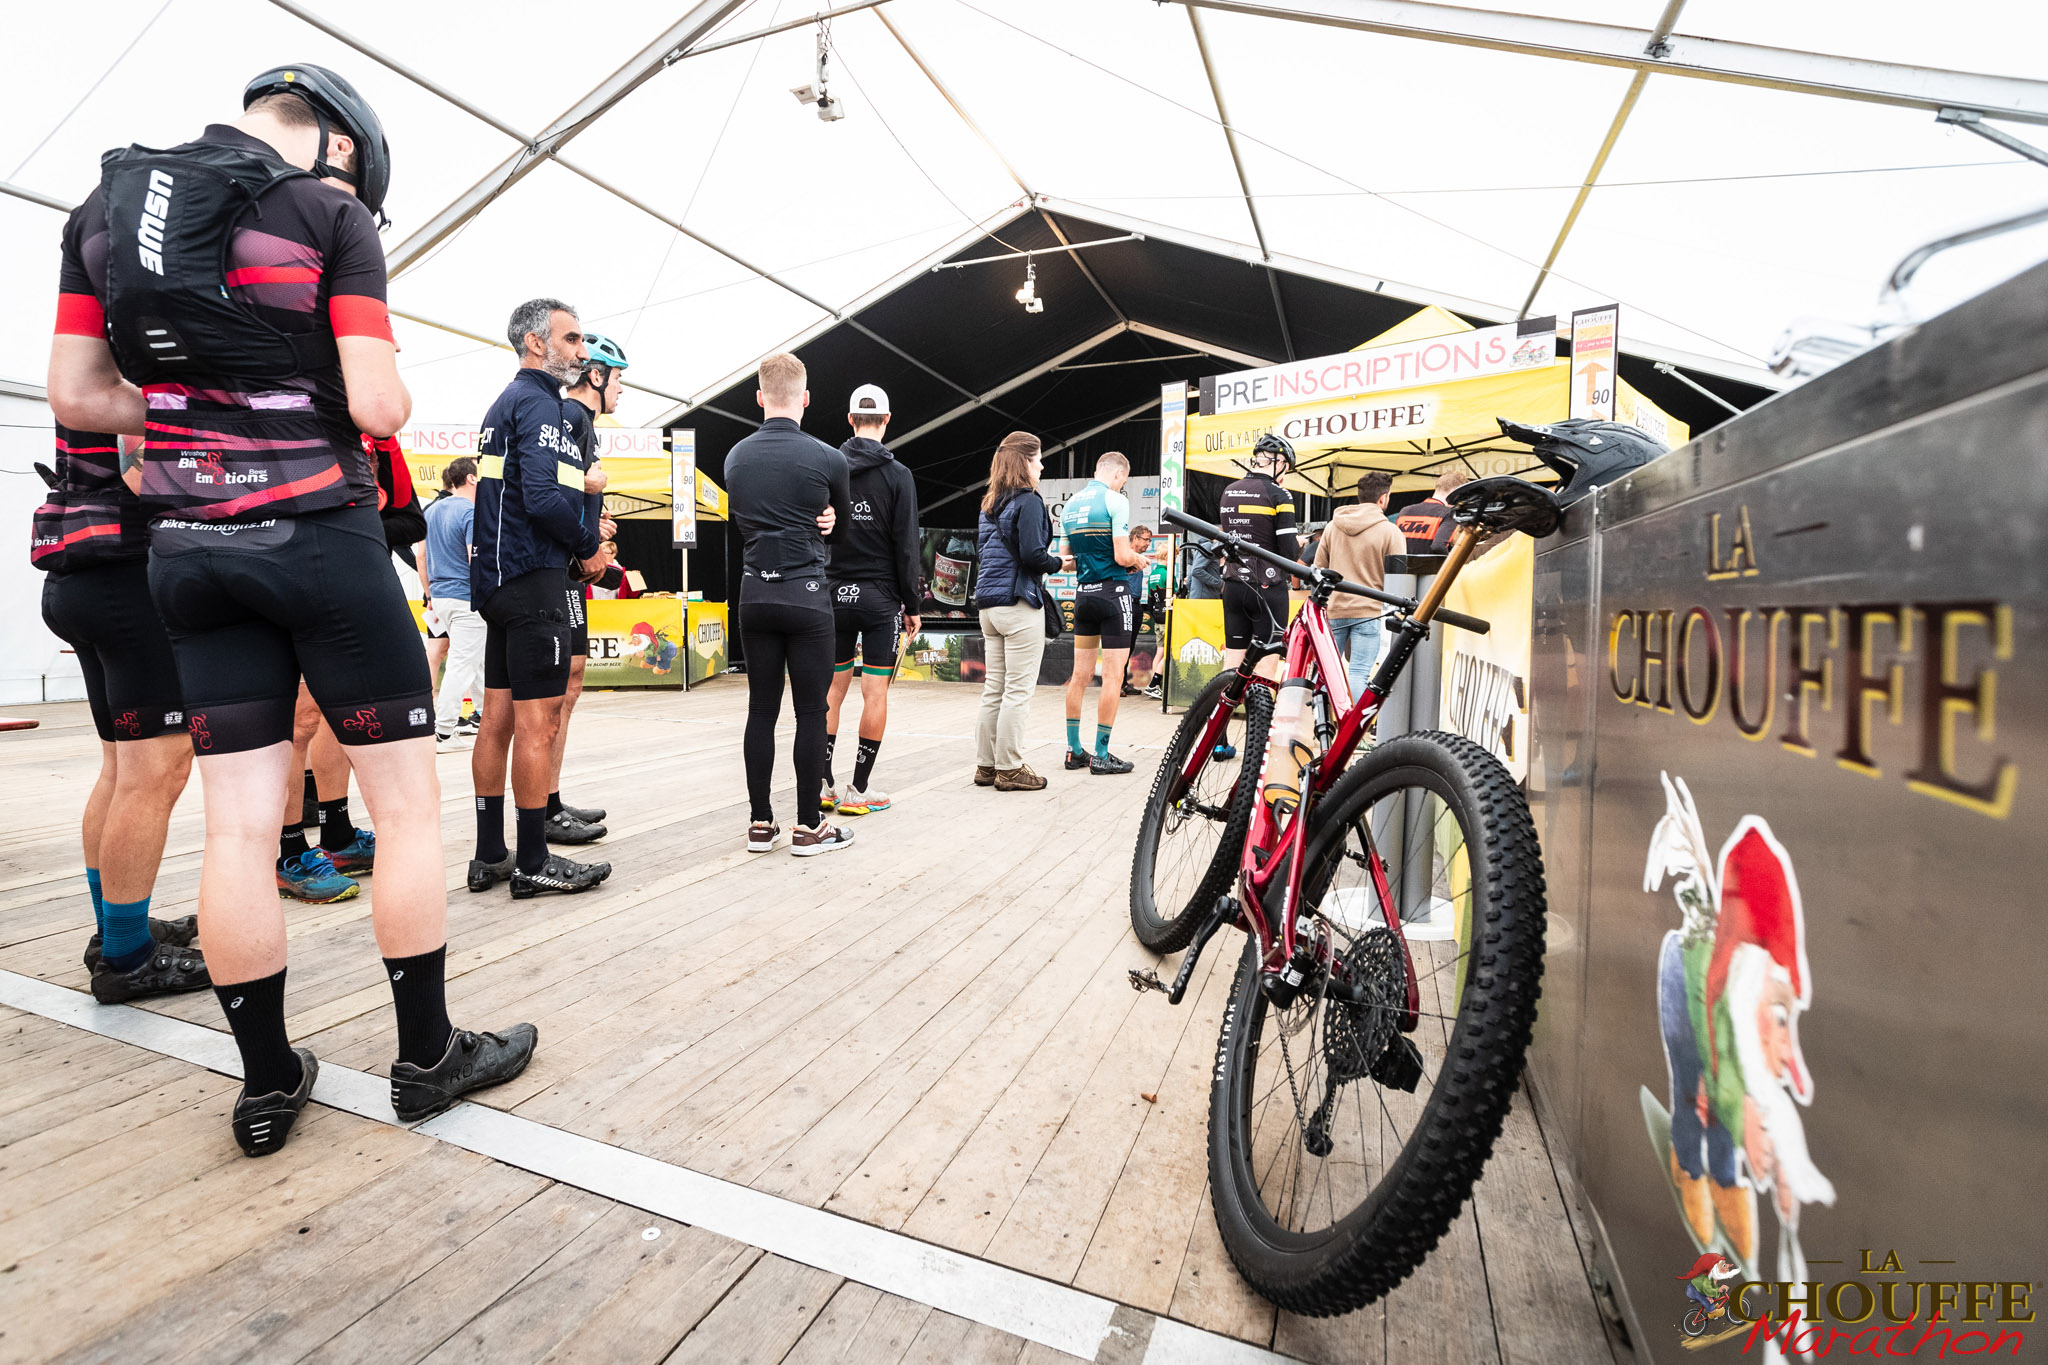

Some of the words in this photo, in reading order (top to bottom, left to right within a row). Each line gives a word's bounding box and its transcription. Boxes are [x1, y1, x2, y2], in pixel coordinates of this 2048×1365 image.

[138, 169, 173, 276] USWE
[1218, 377, 1268, 408] PRE
[1273, 337, 1506, 398] INSCRIPTIONS
[1592, 388, 1609, 405] 90
[1283, 402, 1426, 440] CHOUFFE
[603, 434, 661, 456] JOUR
[1172, 441, 1184, 453] 90
[683, 475, 693, 485] 90
[1161, 477, 1172, 489] 60
[674, 502, 684, 512] 90
[684, 531, 694, 541] 90
[1399, 520, 1431, 534] KTM
[1706, 504, 1760, 581] LA
[570, 589, 585, 626] SCUDERIA
[697, 622, 721, 644] CHOUFFE
[1609, 602, 2018, 819] CHOUFFE
[1163, 730, 1182, 765] CONTROL
[1216, 1046, 1228, 1081] FAST
[1222, 1003, 1237, 1043] TRAK
[1233, 976, 1243, 998] GRID
